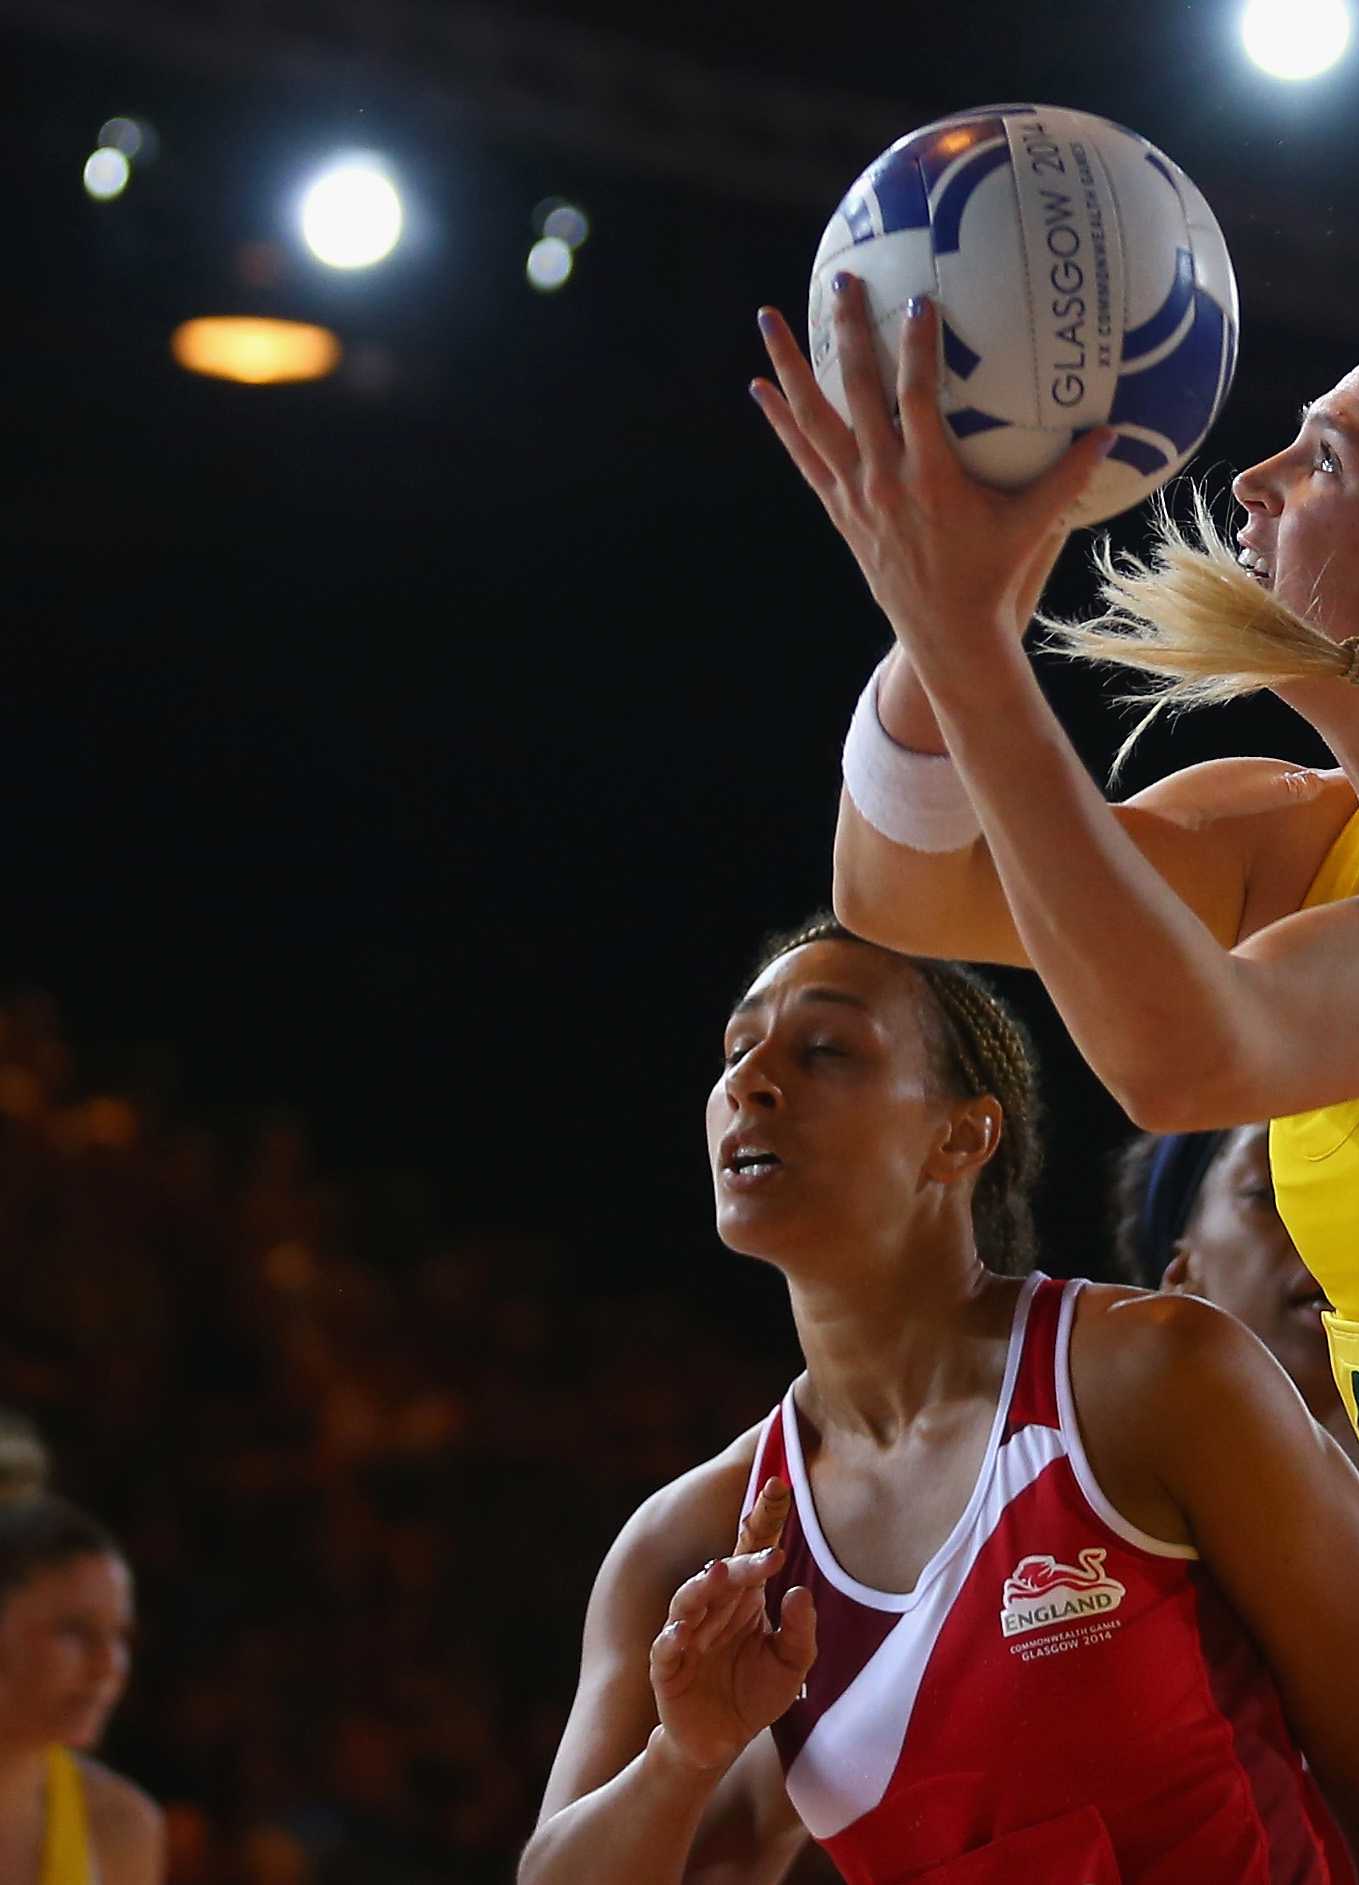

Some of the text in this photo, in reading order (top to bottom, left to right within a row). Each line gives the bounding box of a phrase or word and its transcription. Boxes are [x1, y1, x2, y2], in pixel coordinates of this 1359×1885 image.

[1039, 190, 1085, 408] GLASGOW
[1004, 1593, 1112, 1633] ENGLAND
[1010, 1620, 1121, 1655] COMMONWEALTH GAMES
[1021, 1631, 1112, 1662] GLASGOW 2014
